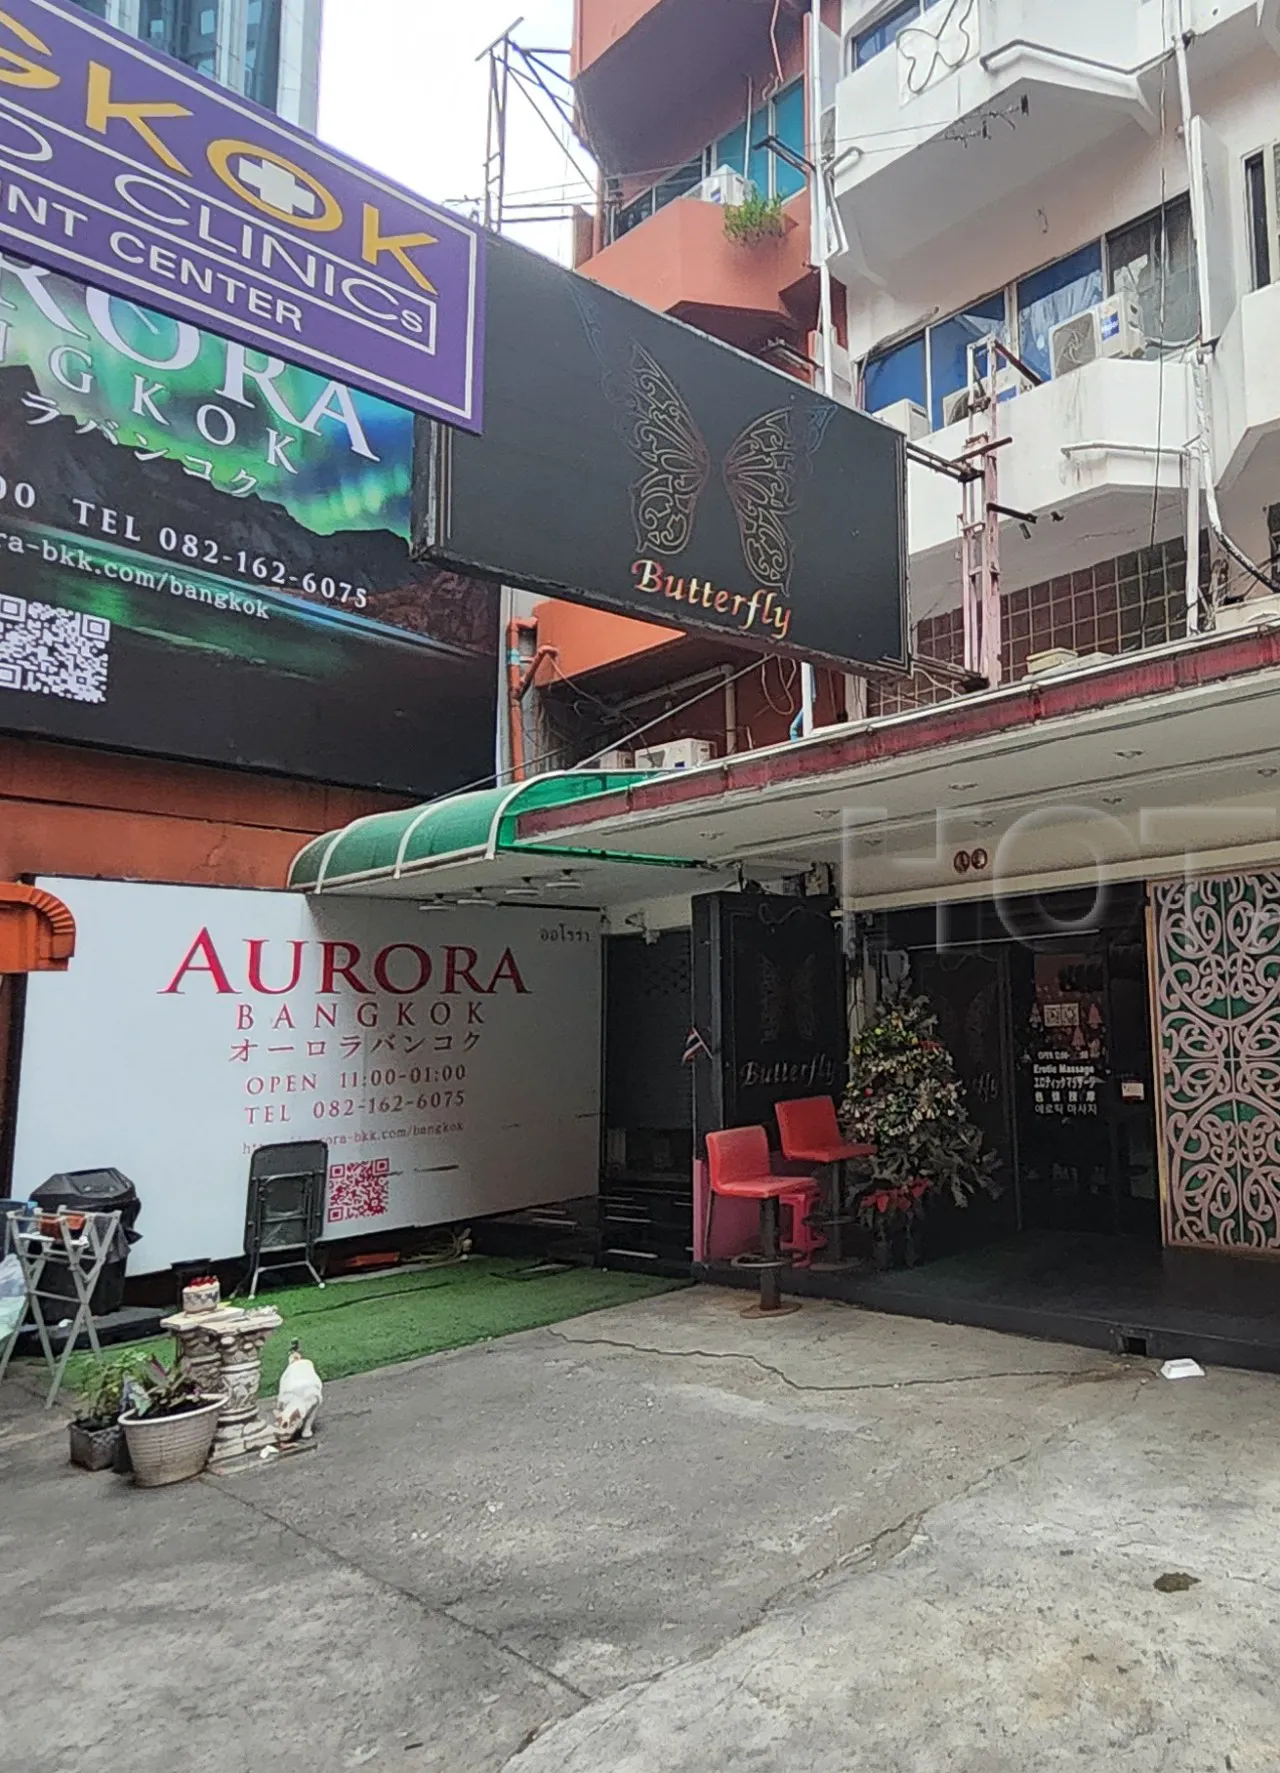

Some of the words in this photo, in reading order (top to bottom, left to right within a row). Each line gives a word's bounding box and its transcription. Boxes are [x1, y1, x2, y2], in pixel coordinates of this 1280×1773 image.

[109, 231, 303, 333] CENTER
[0, 318, 299, 475] GKOK
[72, 498, 141, 542] TEL
[158, 526, 369, 609] 082-162-6075
[631, 559, 792, 640] Butterfly
[156, 926, 533, 995] AURORA
[236, 1001, 485, 1031] BANGKOK
[228, 1030, 481, 1063] オーロラバンコク
[739, 1052, 836, 1088] Butterfly
[246, 1073, 317, 1096] OPEN
[340, 1063, 467, 1090] 11:00-01:00
[244, 1103, 291, 1125] TEL
[312, 1090, 465, 1120] 082-162-6075
